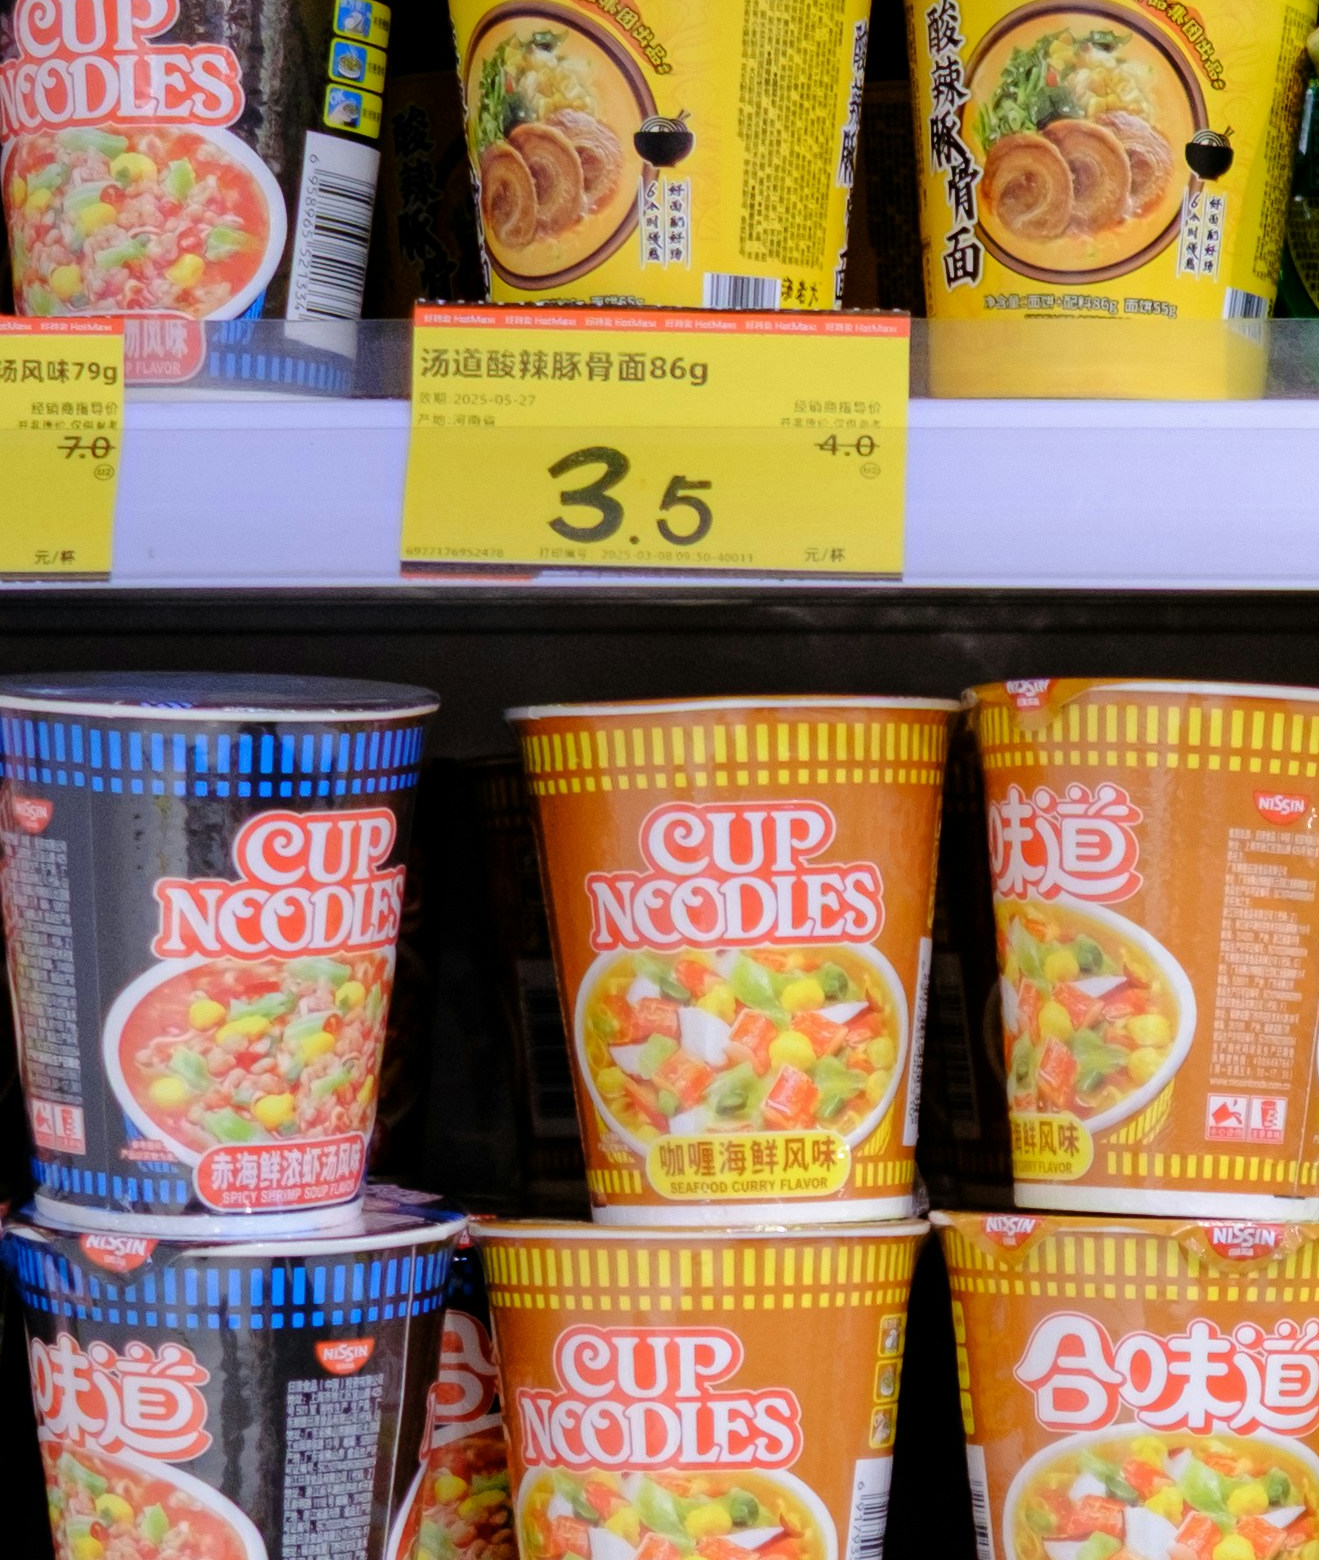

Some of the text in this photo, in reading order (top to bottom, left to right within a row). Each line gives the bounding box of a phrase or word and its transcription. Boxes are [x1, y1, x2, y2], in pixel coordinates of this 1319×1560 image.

[421, 348, 709, 386] 汤道酸辣豚骨面86g
[57, 435, 116, 460] 7.0
[815, 435, 880, 458] 4.0
[547, 445, 713, 547] 3.5
[641, 802, 835, 874] CUP
[589, 867, 882, 947] NOODLES
[657, 1139, 840, 1174] 咖喱海鲜风味
